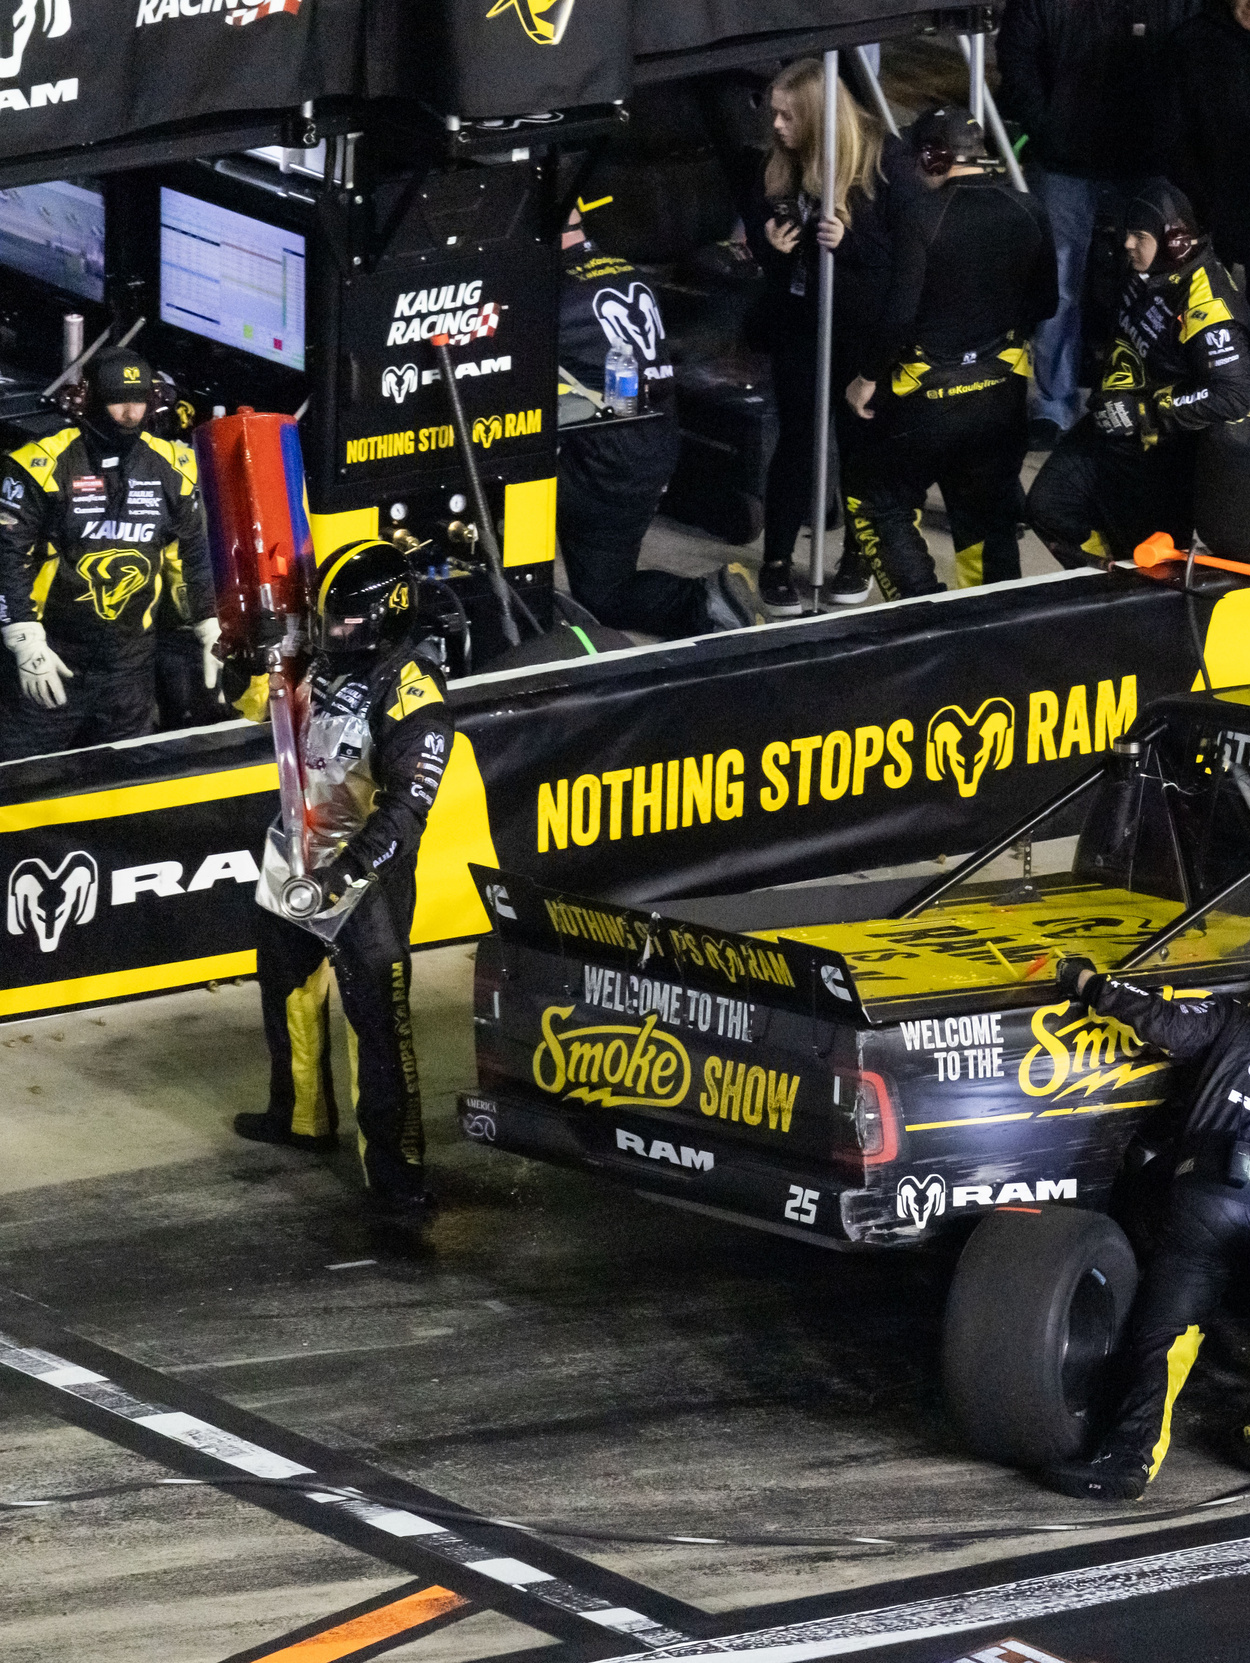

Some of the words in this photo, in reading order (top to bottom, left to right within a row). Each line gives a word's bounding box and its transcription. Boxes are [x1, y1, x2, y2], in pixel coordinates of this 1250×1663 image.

[0, 78, 79, 110] AM
[394, 280, 483, 318] KAULIG
[387, 308, 480, 346] RACING
[643, 365, 674, 380] AM
[346, 431, 415, 464] NOTHING
[504, 409, 542, 437] RAM
[81, 520, 156, 542] KAULIG
[537, 747, 745, 853] NOTHING
[760, 717, 914, 812] STOPS
[1027, 674, 1138, 764] RAM
[110, 850, 262, 907] RA
[584, 965, 682, 1026] WELCOME
[687, 989, 714, 1033] TO
[900, 1013, 1005, 1051] WELCOME
[533, 1005, 692, 1108] Smoke
[699, 1055, 801, 1134] SHOW
[934, 1051, 962, 1082] TO
[967, 1047, 1005, 1080] THE
[615, 1126, 715, 1172] RAM
[783, 1184, 821, 1225] 25
[951, 1178, 1078, 1207] RAM
